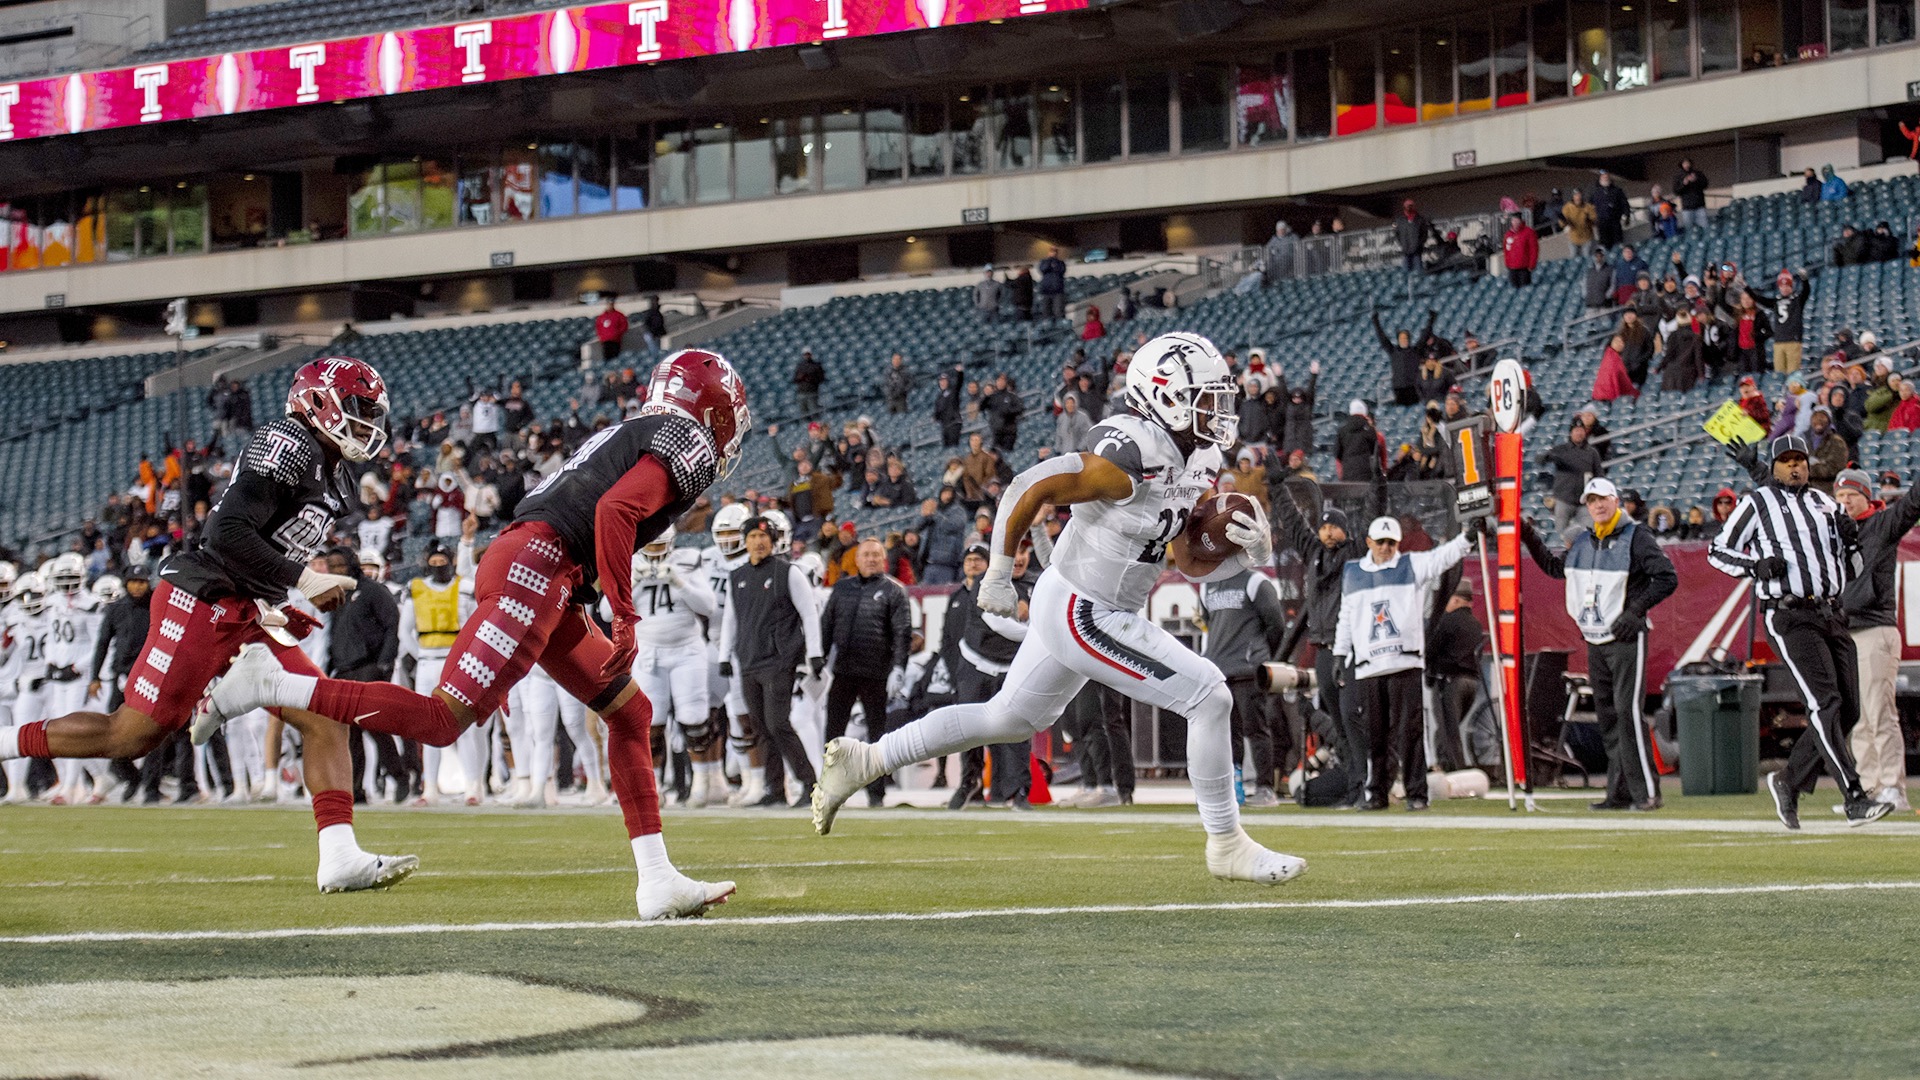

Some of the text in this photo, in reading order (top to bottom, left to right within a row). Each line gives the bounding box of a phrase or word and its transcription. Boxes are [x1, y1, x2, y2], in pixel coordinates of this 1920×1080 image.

[628, 0, 668, 61] T
[454, 21, 492, 83] T
[134, 64, 168, 122] T
[289, 44, 326, 103] T
[318, 357, 353, 381] T
[1494, 378, 1513, 413] P6
[262, 430, 300, 470] T
[679, 428, 715, 474] T
[1457, 428, 1480, 486] 1
[210, 604, 227, 624] T
[643, 583, 675, 616] 74
[52, 619, 75, 643] 80
[1369, 600, 1400, 643] A
[1369, 645, 1403, 657] AMERICAN
